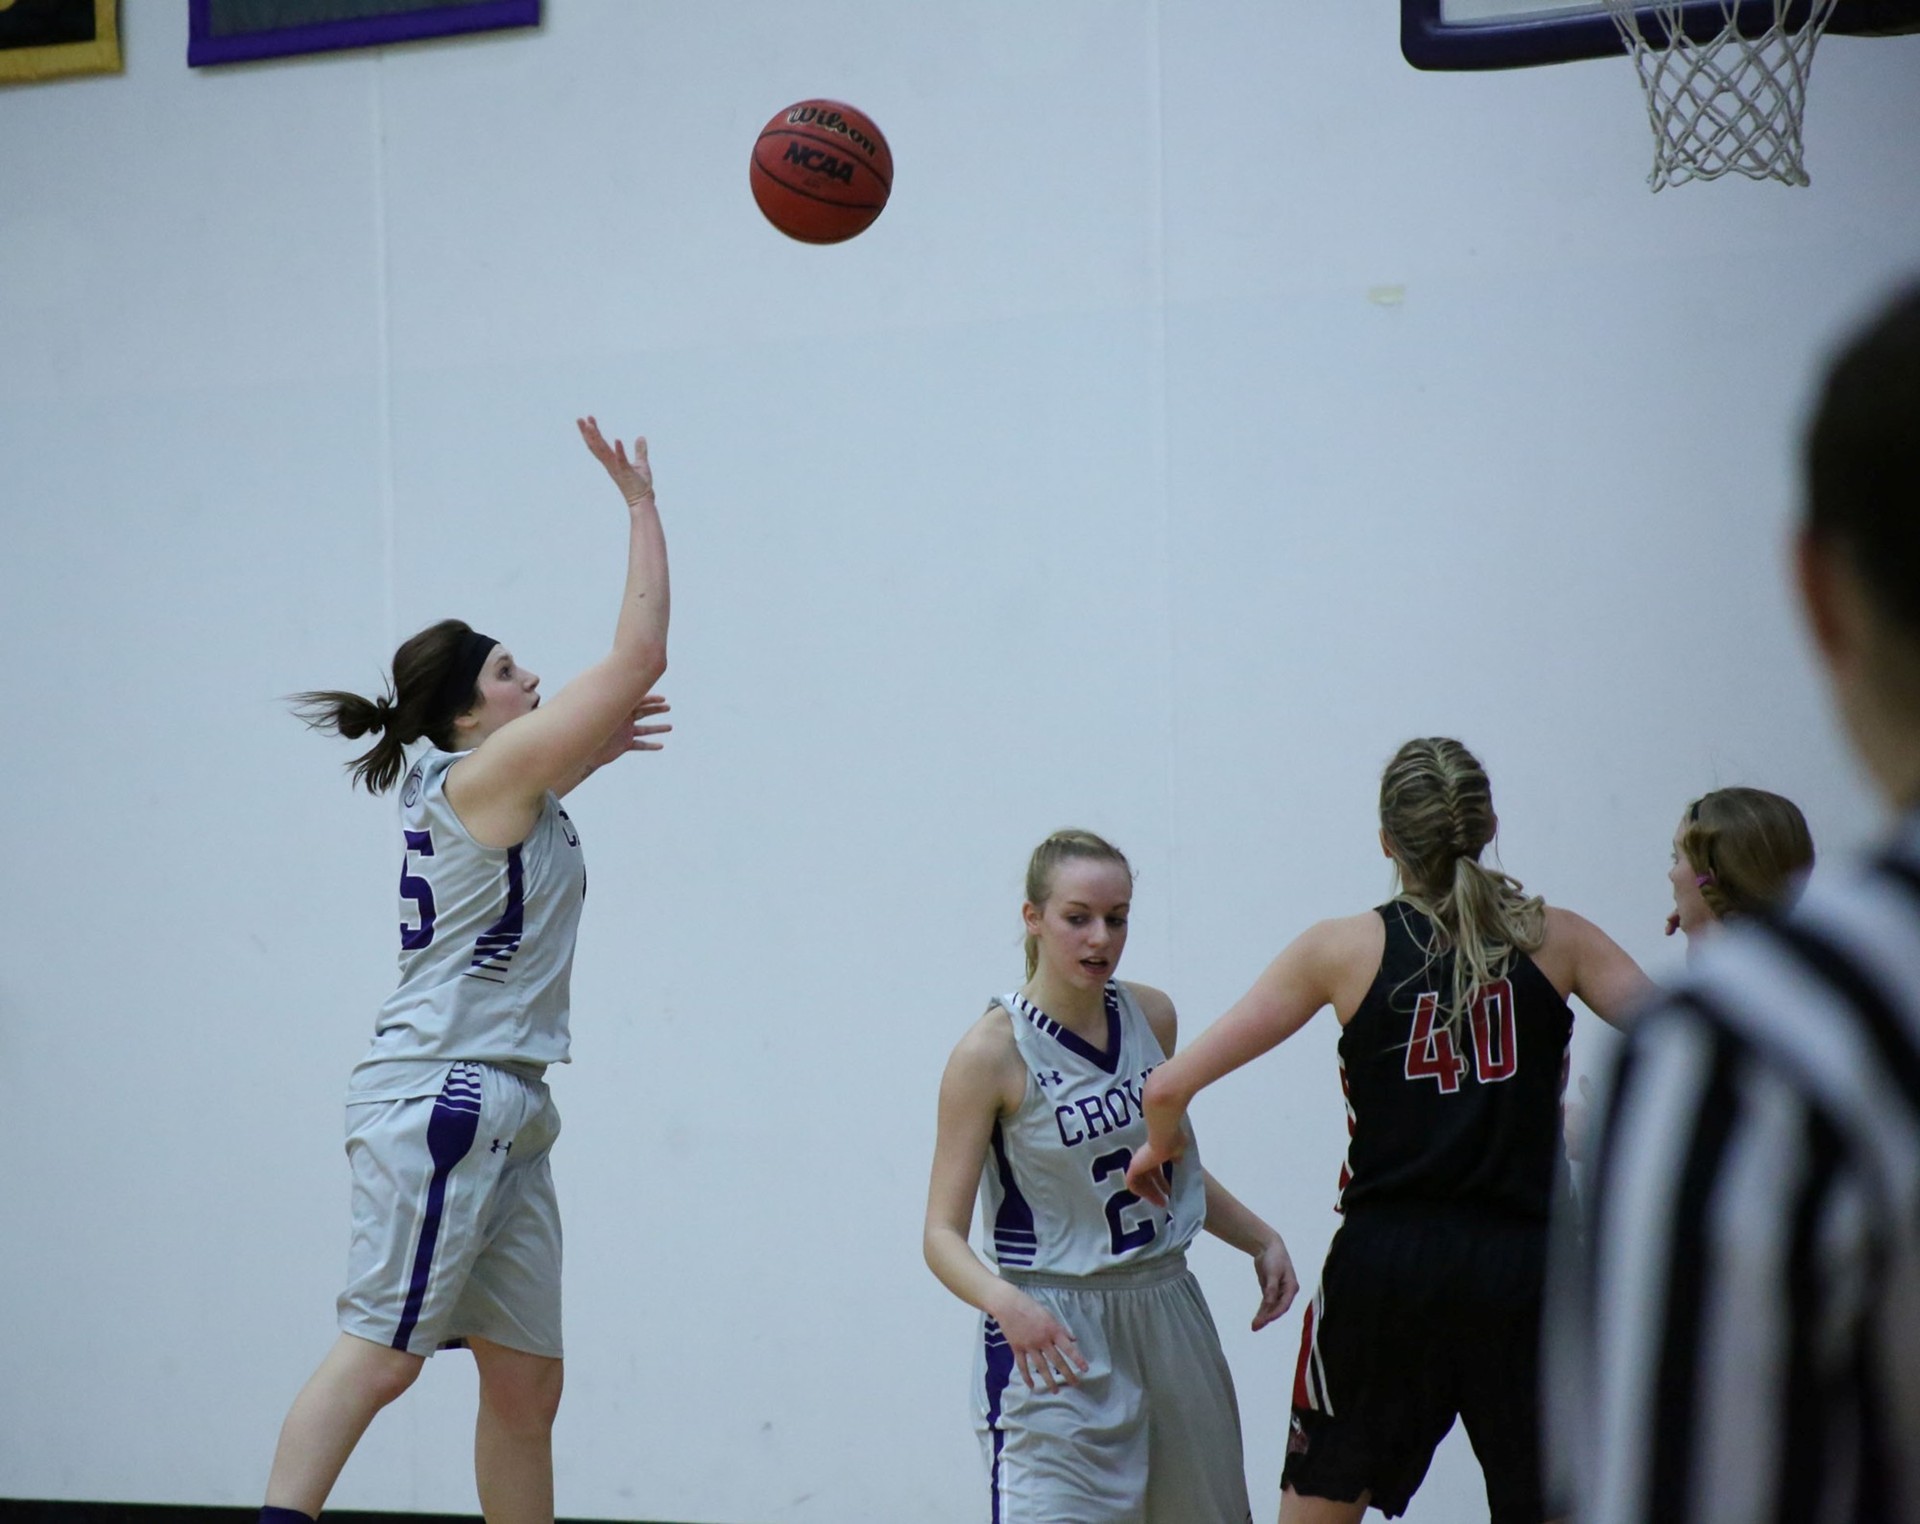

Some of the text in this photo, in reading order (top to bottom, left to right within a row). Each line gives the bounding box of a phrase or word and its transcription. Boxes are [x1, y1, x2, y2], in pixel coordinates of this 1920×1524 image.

[783, 141, 854, 185] NCAA
[787, 107, 876, 157] Wilson
[1405, 976, 1517, 1094] 40
[1055, 1061, 1165, 1147] CRO
[1091, 1147, 1173, 1256] 2
